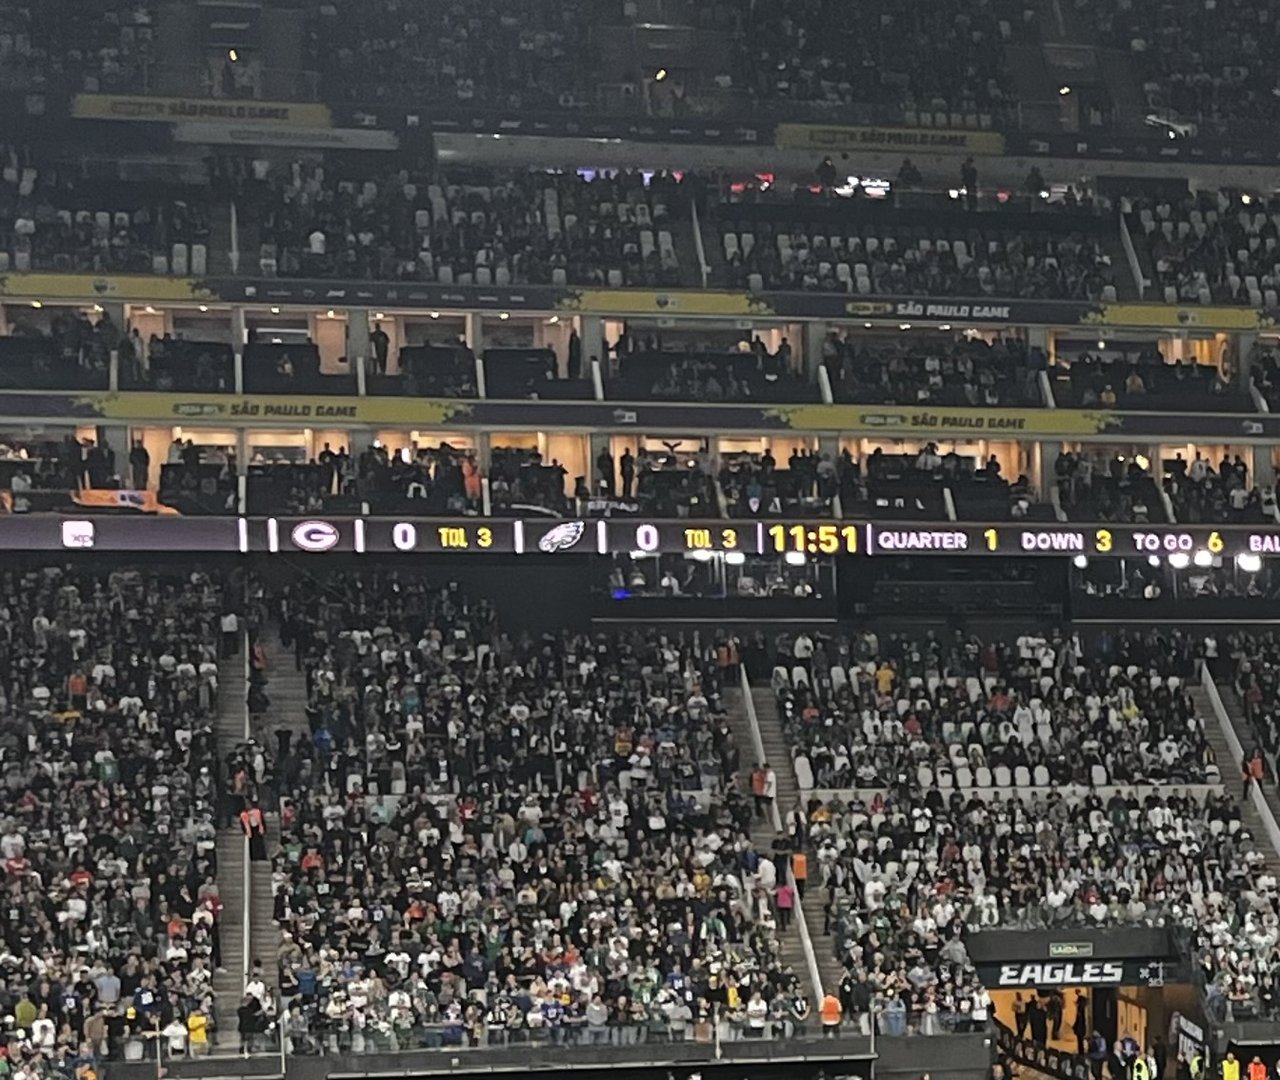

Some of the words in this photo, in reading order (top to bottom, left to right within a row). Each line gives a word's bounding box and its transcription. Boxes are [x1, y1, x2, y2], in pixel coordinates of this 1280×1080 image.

[230, 401, 259, 416] SÃO
[263, 404, 311, 417] PAULO
[315, 405, 357, 417] GAME
[911, 413, 937, 427] SÃO
[941, 415, 984, 428] PAULO
[988, 418, 1025, 430] GAME
[392, 523, 416, 551] 0
[438, 527, 468, 548] TOL
[477, 527, 492, 548] 3
[635, 523, 659, 552] 0
[684, 528, 713, 549] TOL
[721, 528, 737, 549] 3
[769, 526, 858, 553] 11:51
[878, 531, 968, 551] QUARTER
[984, 529, 998, 551] 1
[1021, 531, 1084, 551] DOWN
[1095, 529, 1112, 552] 3
[1132, 533, 1159, 551] TO
[1164, 533, 1193, 551] GO
[1207, 531, 1224, 552] 6
[999, 962, 1123, 985] EAGLES
